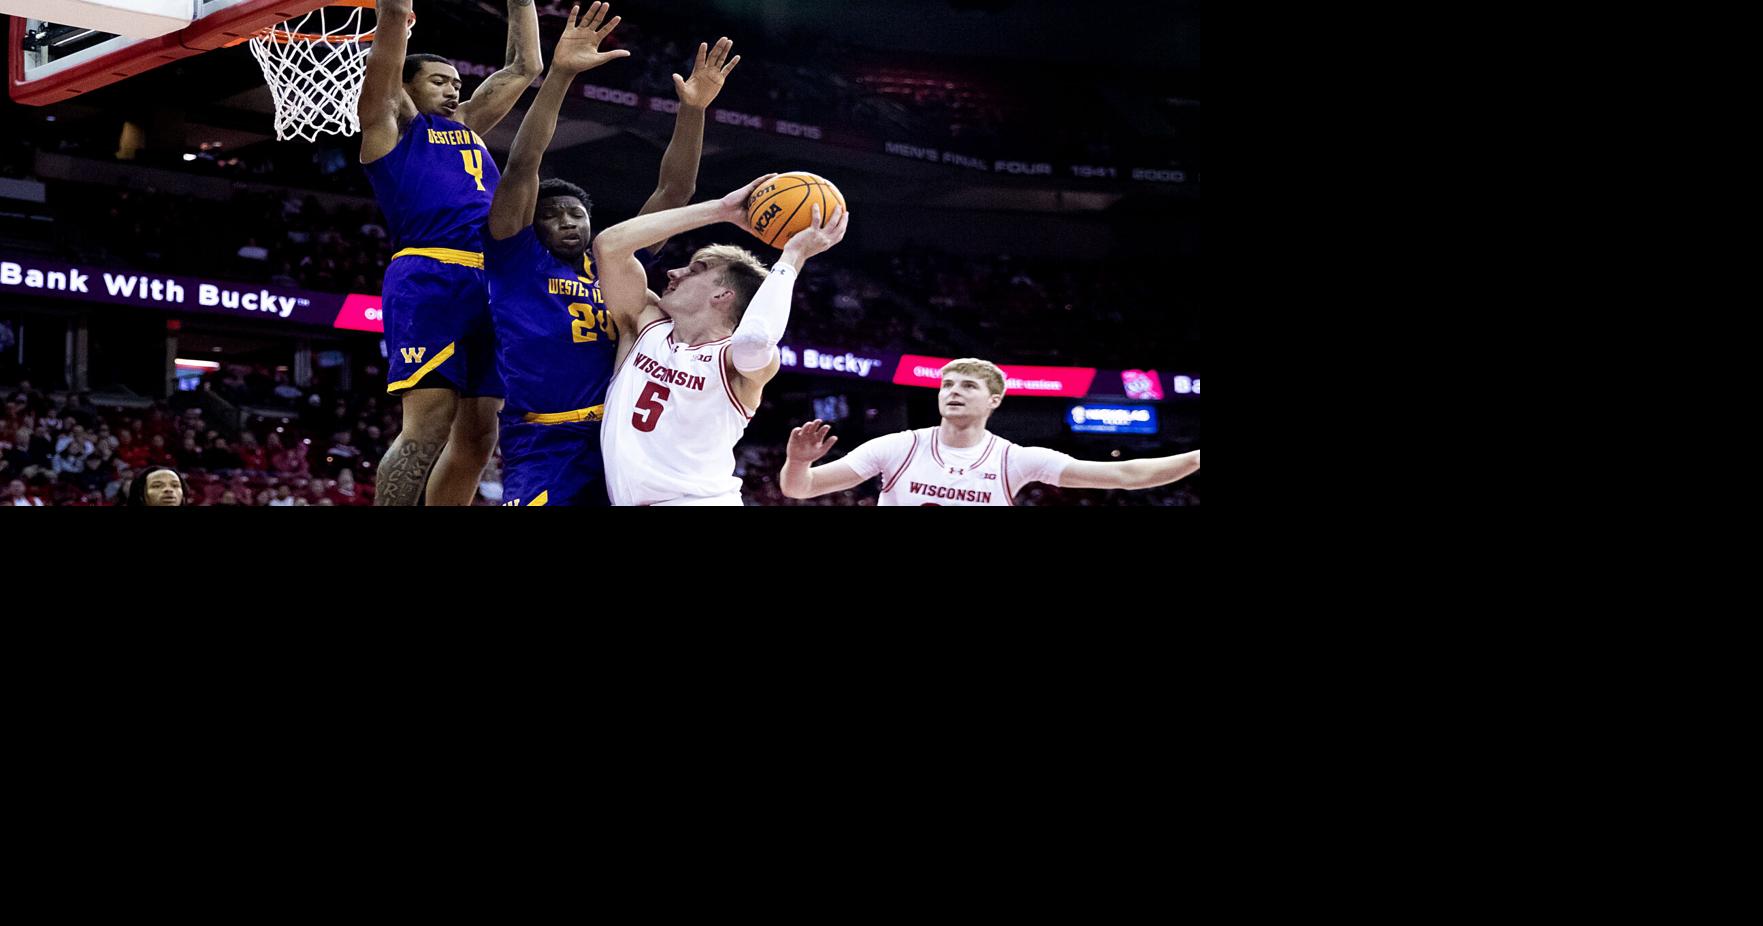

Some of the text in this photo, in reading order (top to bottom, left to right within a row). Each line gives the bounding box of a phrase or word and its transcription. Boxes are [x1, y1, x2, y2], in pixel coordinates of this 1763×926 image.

[583, 84, 638, 107] 2000
[649, 96, 680, 114] 20
[714, 108, 763, 128] 2014
[427, 129, 470, 145] WESTERN
[459, 149, 486, 191] 4
[941, 151, 989, 171] FINAL
[994, 159, 1054, 176] FOUR
[1070, 164, 1118, 179] 1941
[1131, 167, 1185, 182] 2000
[754, 203, 783, 233] NCAA
[0, 261, 89, 294] Bank
[103, 272, 185, 303] With
[400, 347, 427, 364] W
[631, 381, 671, 433] 5
[909, 481, 992, 504] WISCONSIN
